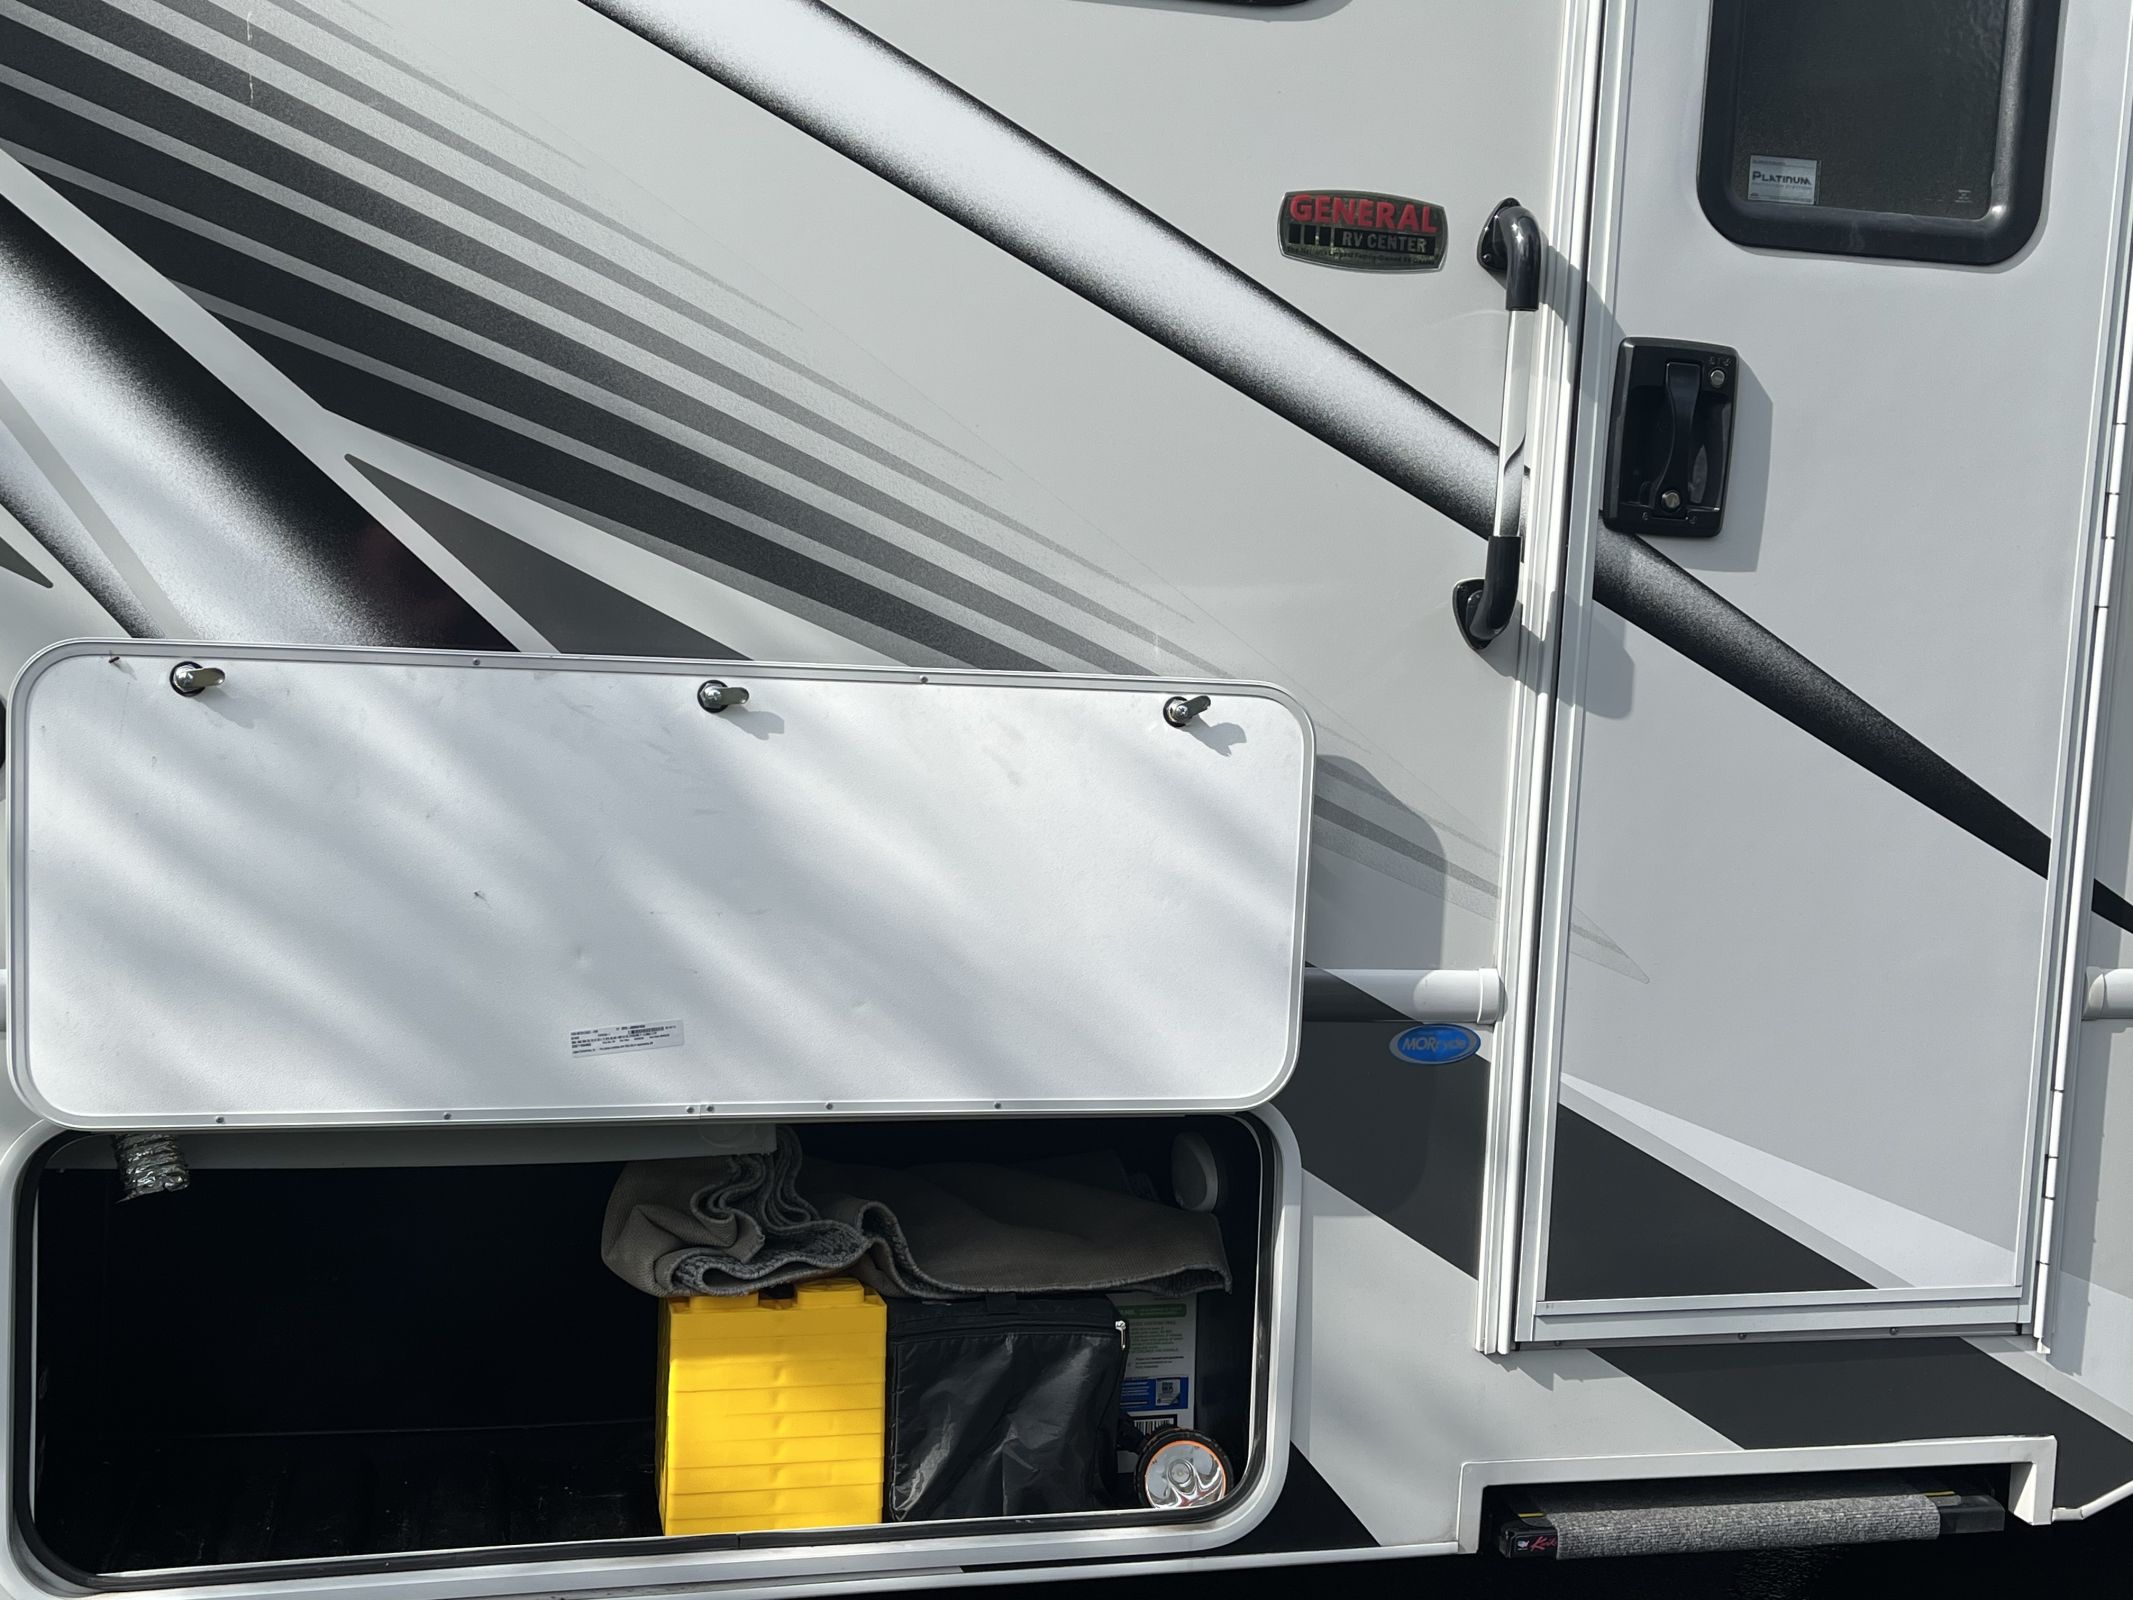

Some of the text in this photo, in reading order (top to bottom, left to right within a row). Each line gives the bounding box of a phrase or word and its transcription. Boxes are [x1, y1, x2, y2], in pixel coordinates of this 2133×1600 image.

[1289, 194, 1439, 234] GENERAL
[1341, 231, 1428, 254] RV CENTER
